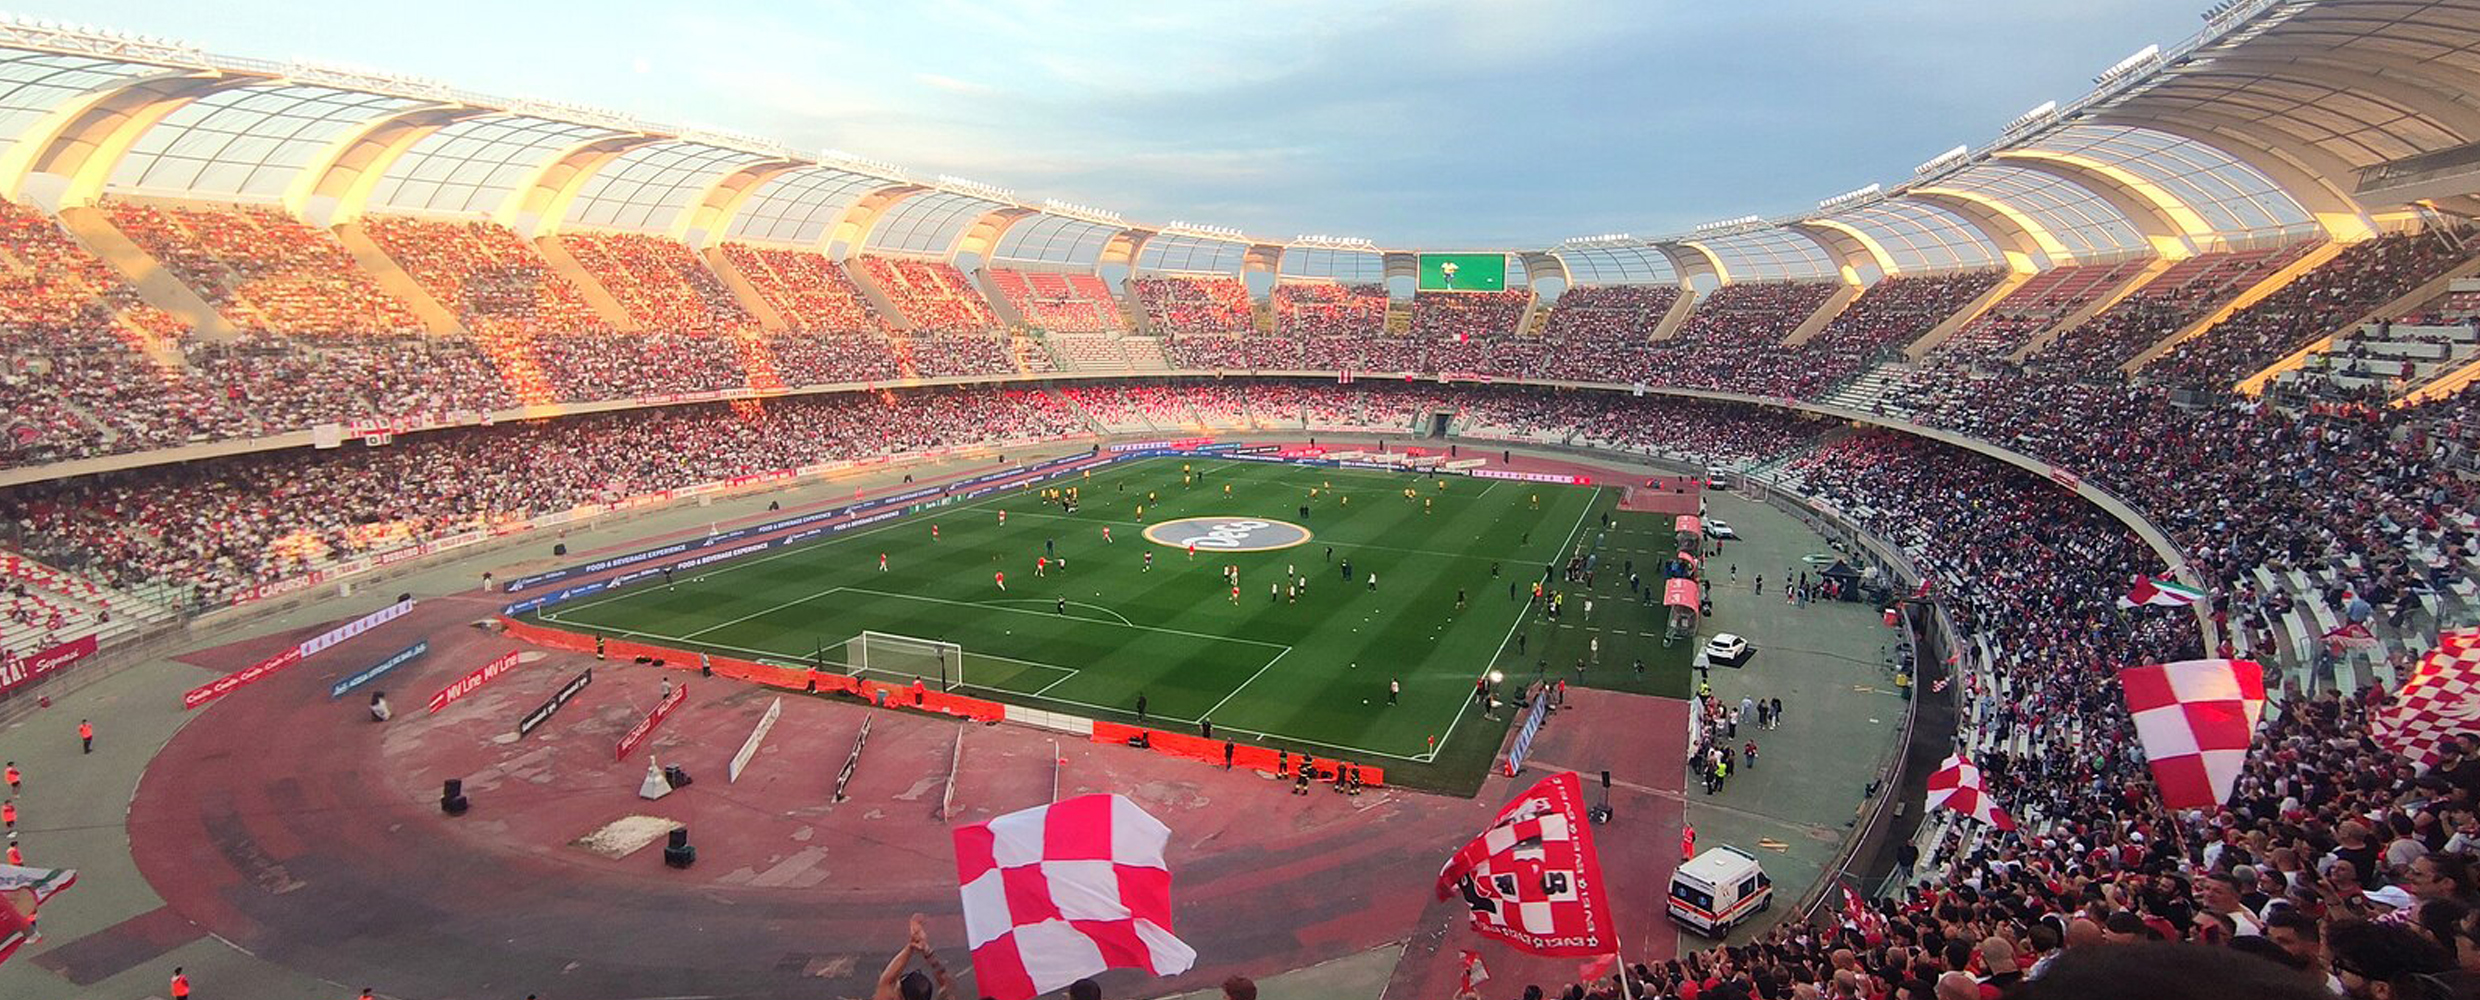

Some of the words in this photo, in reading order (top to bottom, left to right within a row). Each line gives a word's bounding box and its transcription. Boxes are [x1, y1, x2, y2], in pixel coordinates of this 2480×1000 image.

[586, 562, 605, 572] FOOD
[613, 553, 647, 567] BEVERAGE
[648, 544, 686, 559] EXPERIENCE
[678, 561, 696, 570] FOOD
[702, 551, 732, 565] BEVERAGE
[733, 542, 768, 556] EXPERIENCE
[259, 575, 310, 598] CAPURSO
[446, 682, 462, 702] MV
[463, 675, 482, 692] Line
[484, 663, 498, 681] MV
[500, 654, 518, 672] Line
